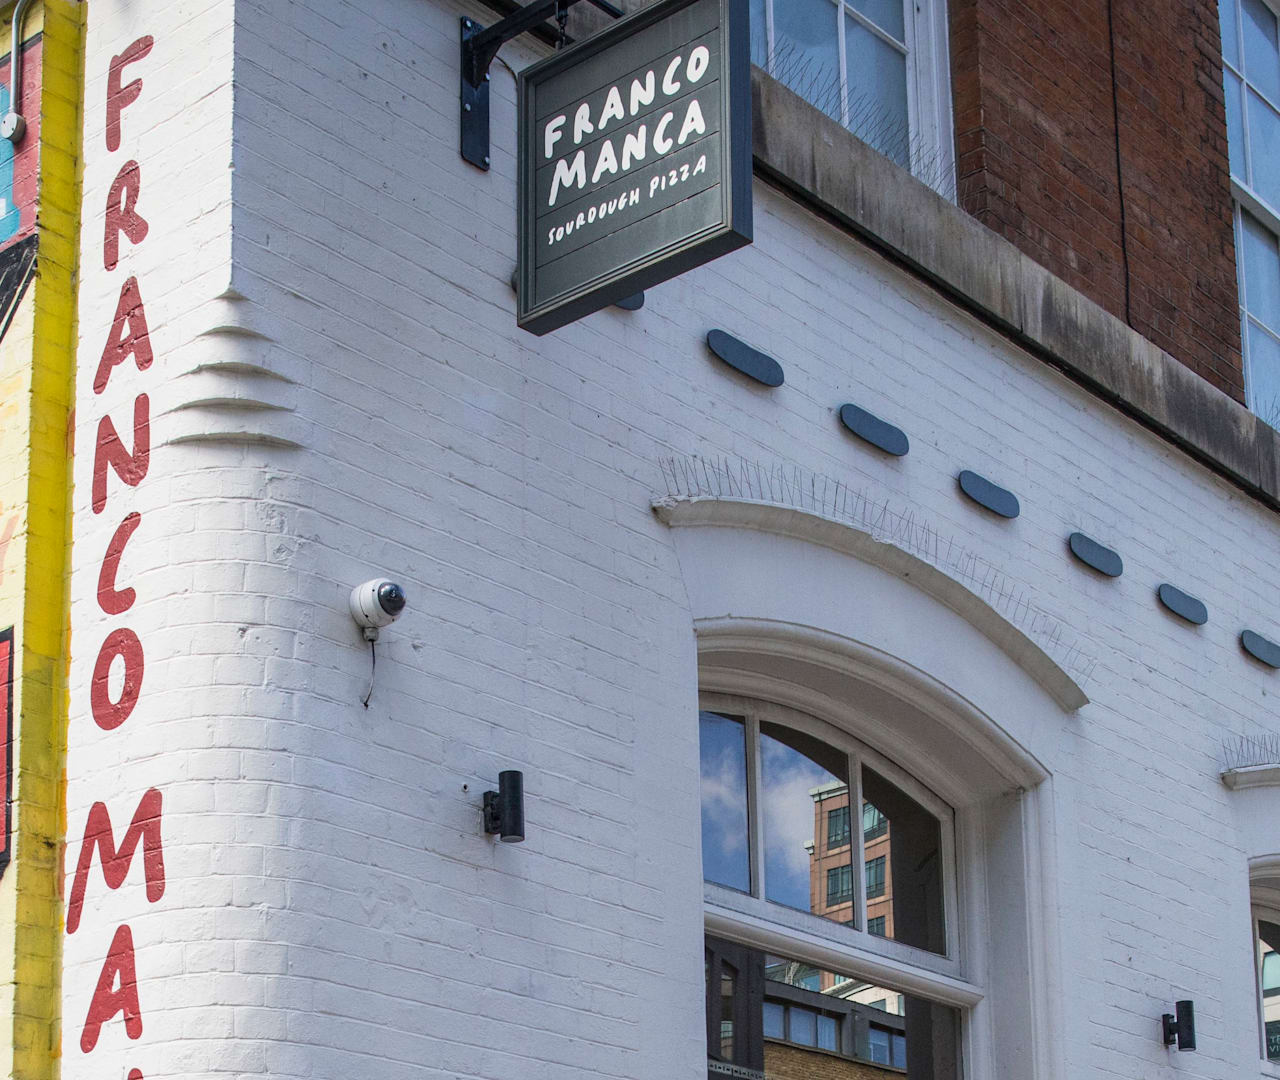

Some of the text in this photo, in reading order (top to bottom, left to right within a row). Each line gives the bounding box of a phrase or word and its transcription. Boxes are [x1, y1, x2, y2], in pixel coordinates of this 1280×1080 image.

[544, 45, 710, 159] FRANCO
[548, 99, 707, 207] MANCA
[548, 154, 707, 246] SOURDOUGH PIZZA
[90, 35, 155, 731] FRANCO
